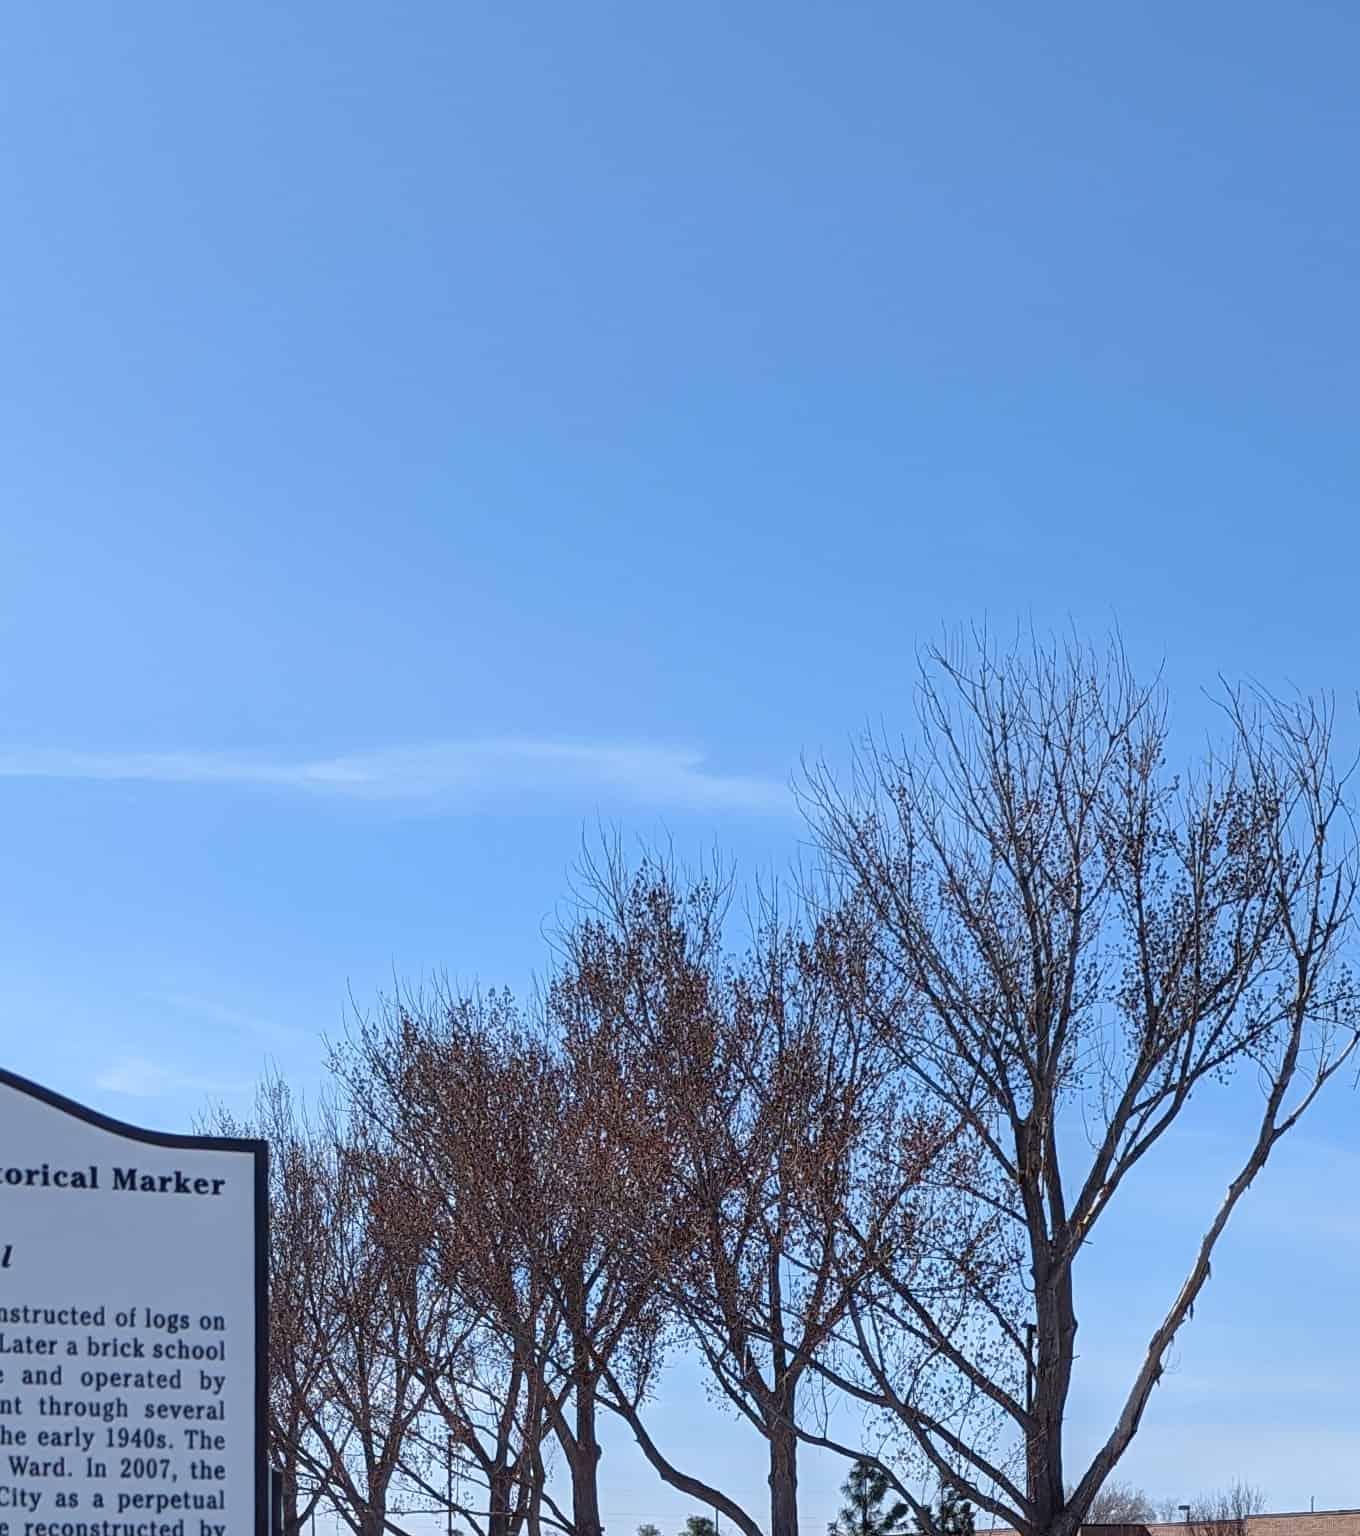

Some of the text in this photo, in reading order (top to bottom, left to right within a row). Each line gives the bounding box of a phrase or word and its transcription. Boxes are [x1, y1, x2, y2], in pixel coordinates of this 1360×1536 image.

[111, 1167, 226, 1196] Marker
[114, 1307, 137, 1328] of
[145, 1307, 190, 1335] logs
[199, 1315, 225, 1331] on
[66, 1340, 79, 1356] a
[87, 1335, 145, 1359] brick
[152, 1338, 225, 1361] school
[21, 1364, 62, 1386] and
[80, 1368, 182, 1393] operated
[199, 1369, 226, 1396] by
[39, 1395, 129, 1423] through
[144, 1399, 225, 1421] several
[37, 1426, 95, 1453] early
[107, 1427, 174, 1449] 1940s.
[183, 1429, 225, 1451] The
[8, 1455, 73, 1478] Ward.
[86, 1457, 107, 1478] In
[119, 1457, 178, 1483] 2007,
[190, 1459, 226, 1481] the
[55, 1492, 79, 1509] as
[92, 1493, 105, 1509] a
[117, 1489, 225, 1515] perpetual
